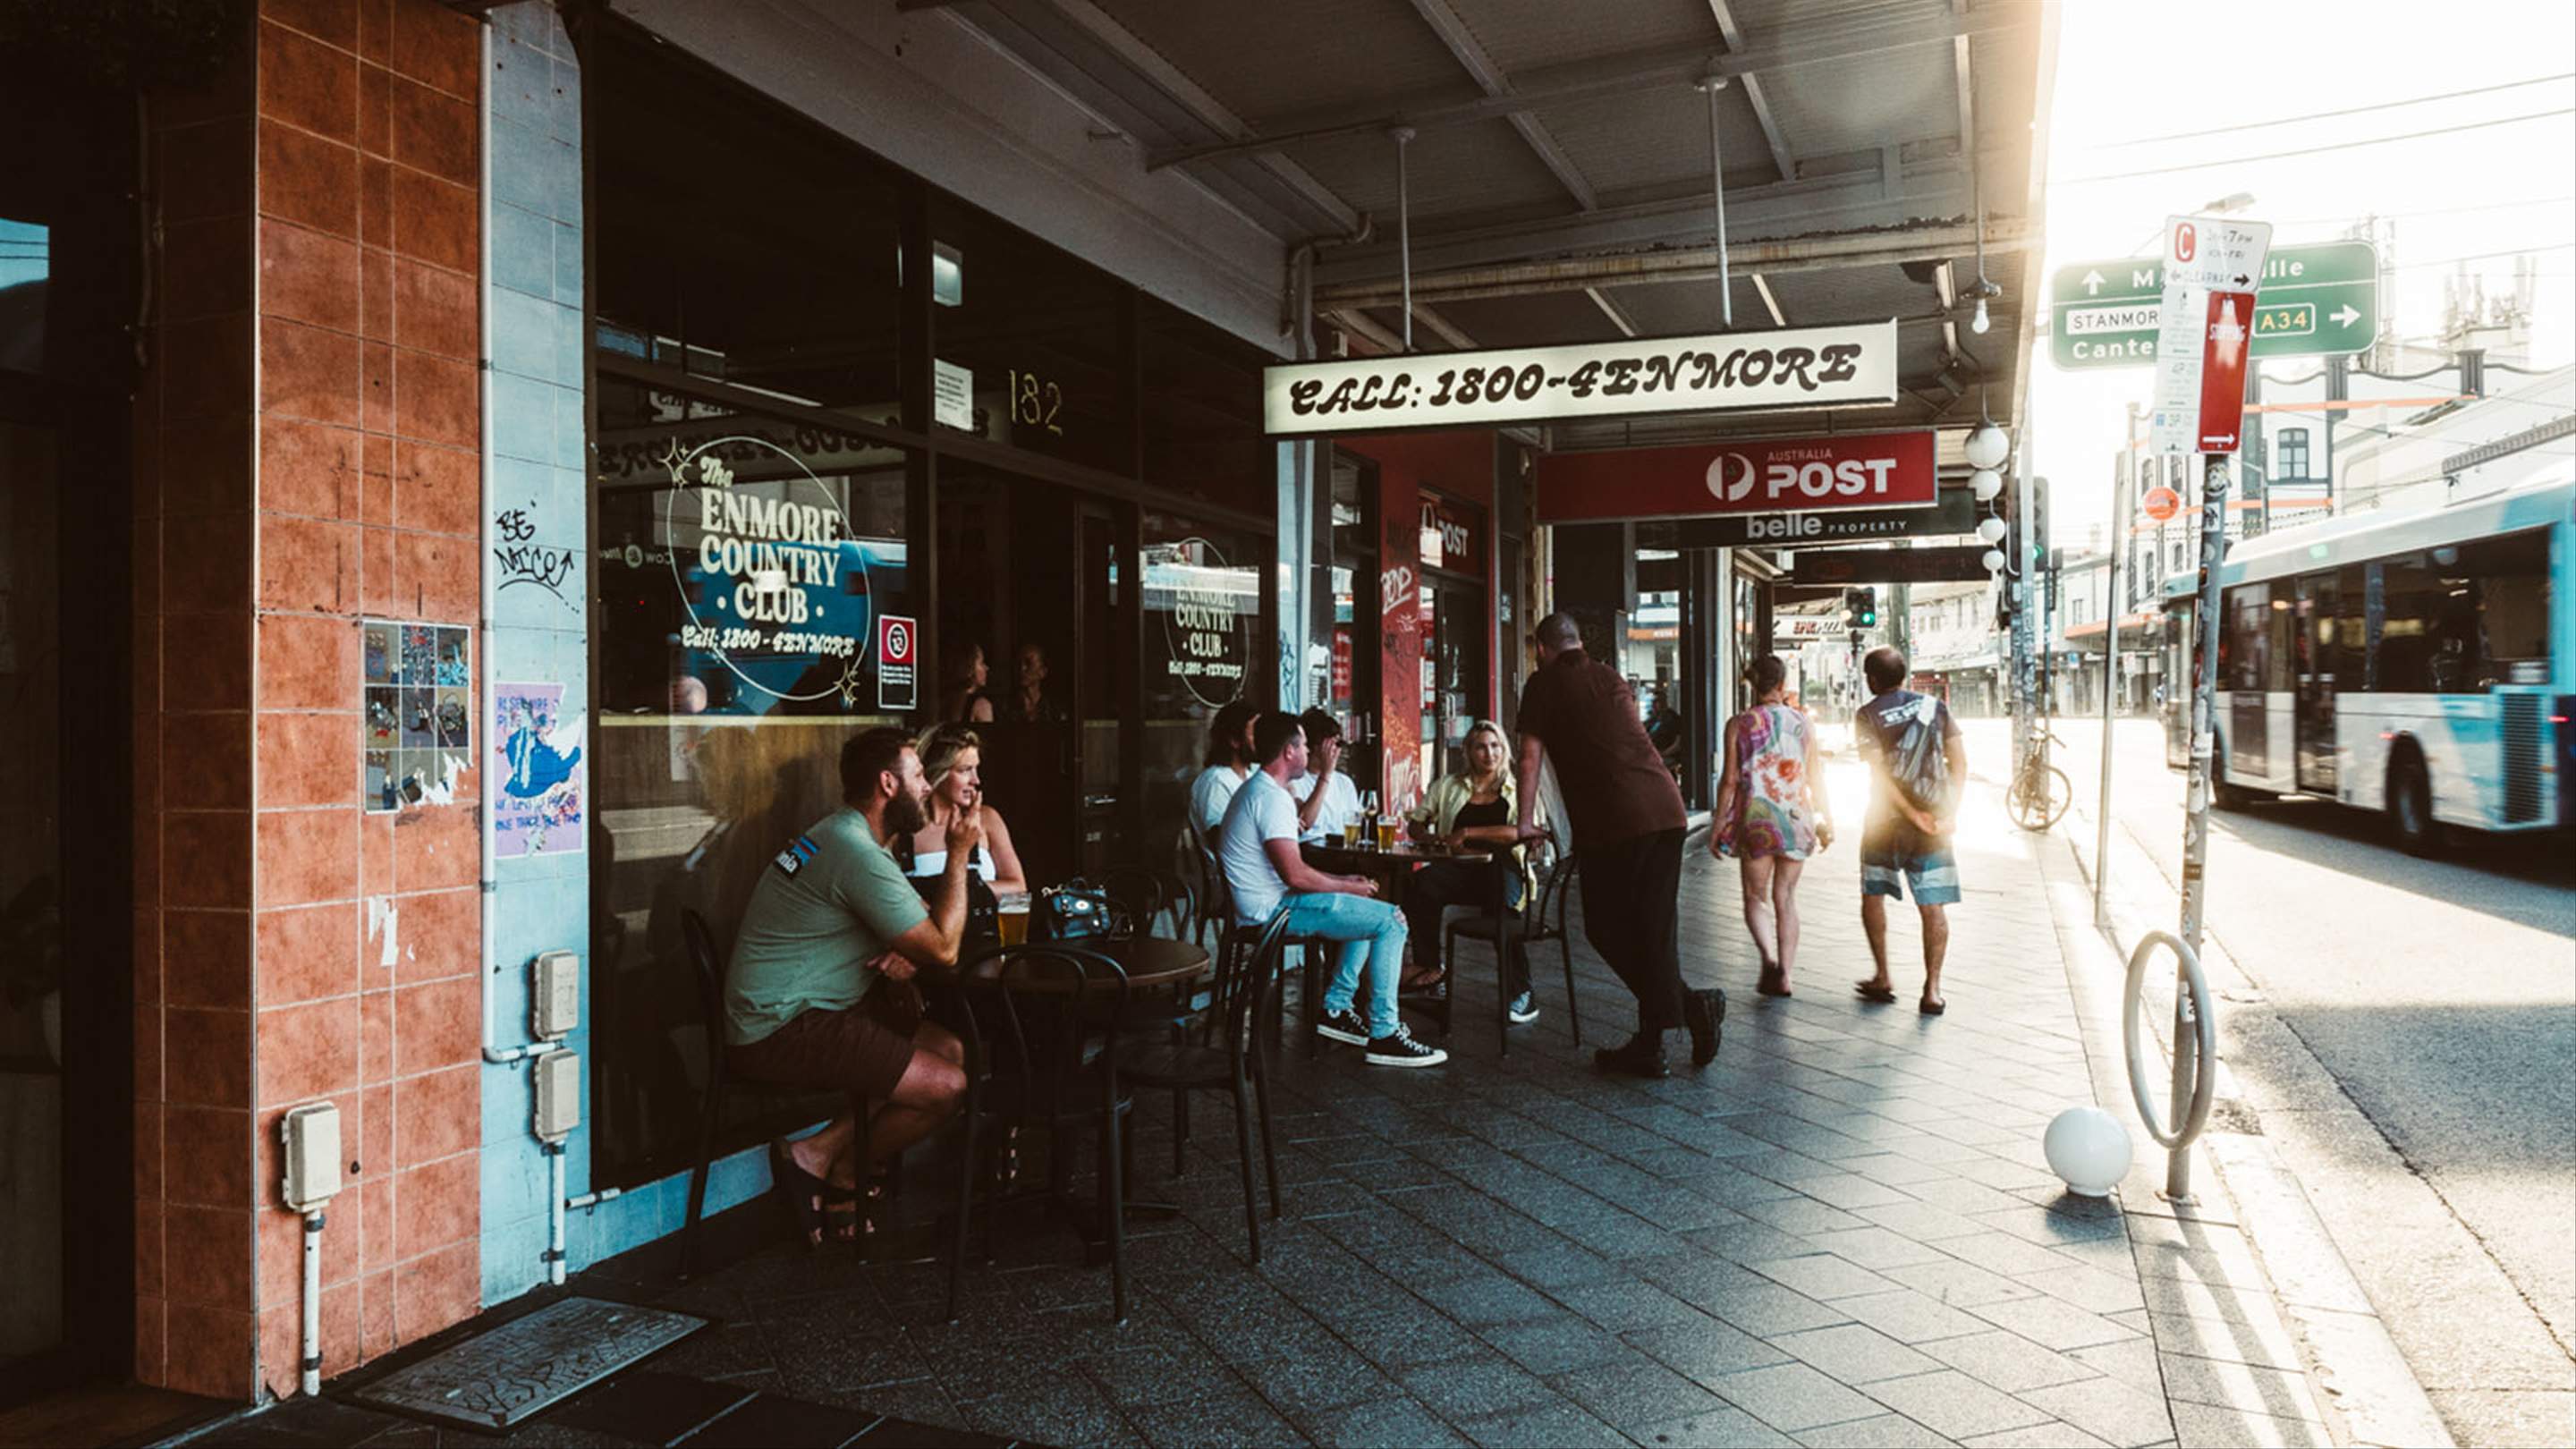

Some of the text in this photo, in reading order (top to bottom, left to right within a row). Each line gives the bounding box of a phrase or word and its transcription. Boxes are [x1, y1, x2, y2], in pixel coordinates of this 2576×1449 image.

[2072, 310, 2159, 330] STANMOR
[2259, 311, 2309, 330] A34
[2072, 338, 2154, 360] Cante
[1290, 343, 1861, 417] CALL: 1800-4ENMORE
[1008, 369, 1063, 437] 182
[1767, 447, 1834, 462] AUSTRALIA
[699, 455, 733, 489] The
[1767, 457, 1898, 499] POST
[699, 487, 842, 549] ENMORE
[1746, 513, 1908, 539] belle PROPERTY
[699, 534, 841, 588] COUNTRY
[734, 580, 809, 624] CLUB
[1175, 604, 1233, 632] COUNTRY
[1190, 633, 1222, 657] CLUB
